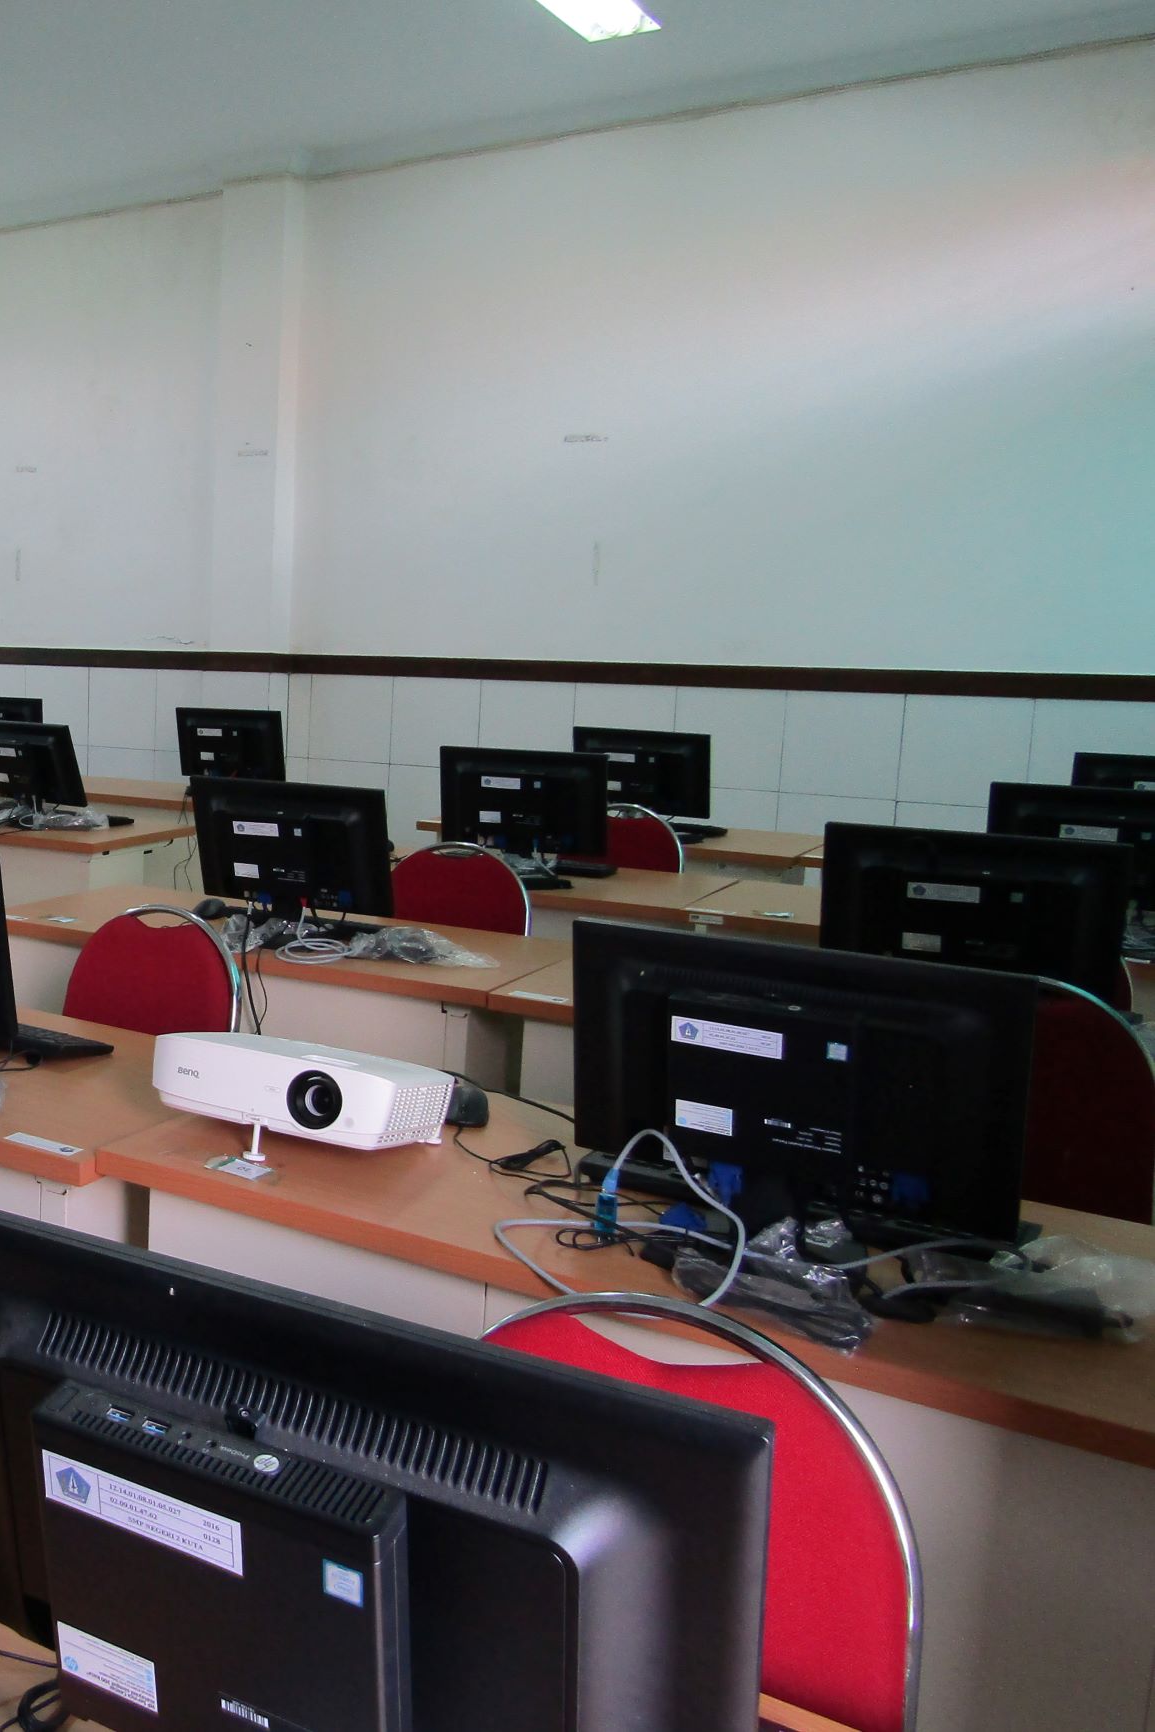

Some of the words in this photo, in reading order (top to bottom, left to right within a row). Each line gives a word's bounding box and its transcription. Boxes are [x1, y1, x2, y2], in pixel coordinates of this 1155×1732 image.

[177, 1066, 199, 1079] BenQ
[202, 1520, 220, 1531] 2016
[127, 1516, 144, 1527] SMP
[181, 1537, 203, 1551] KUTA
